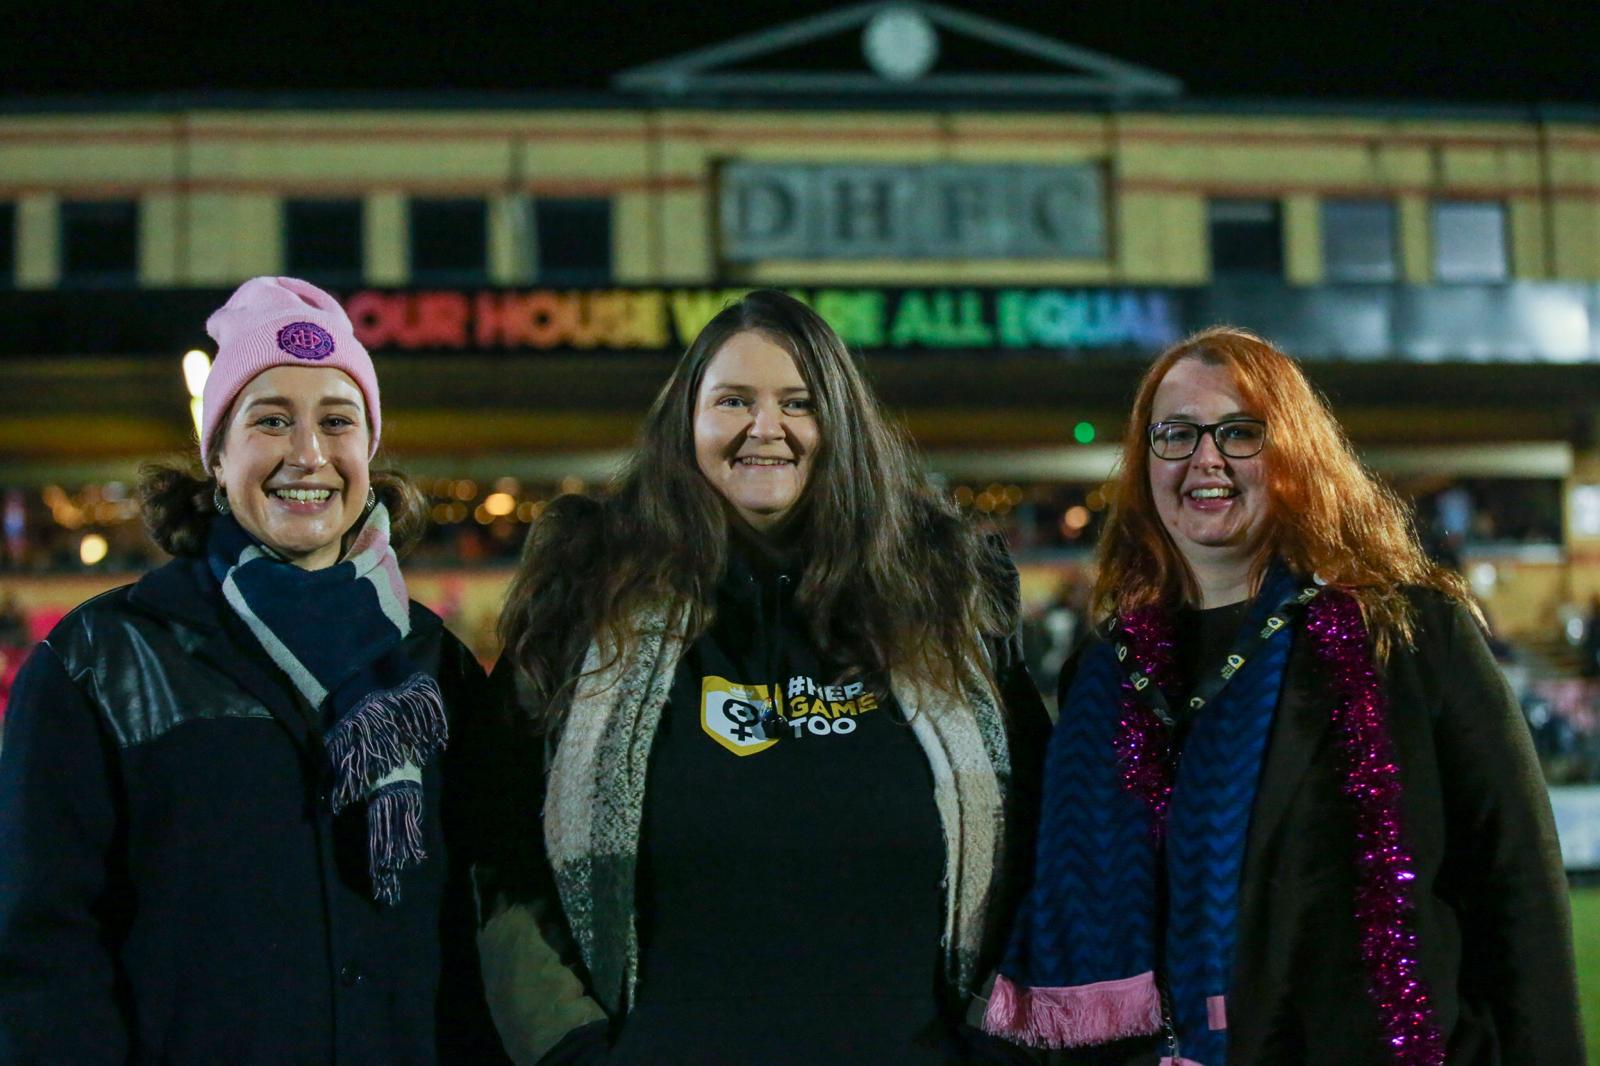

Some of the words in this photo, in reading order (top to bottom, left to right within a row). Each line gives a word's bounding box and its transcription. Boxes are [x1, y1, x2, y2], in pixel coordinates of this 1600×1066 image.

[735, 175, 1086, 248] DHFC
[347, 291, 469, 347] OUR
[475, 291, 670, 347] HOUSE
[893, 291, 993, 347] ALL
[1000, 290, 1178, 348] EQUAL
[789, 692, 877, 718] GAME
[789, 716, 856, 738] TOO
